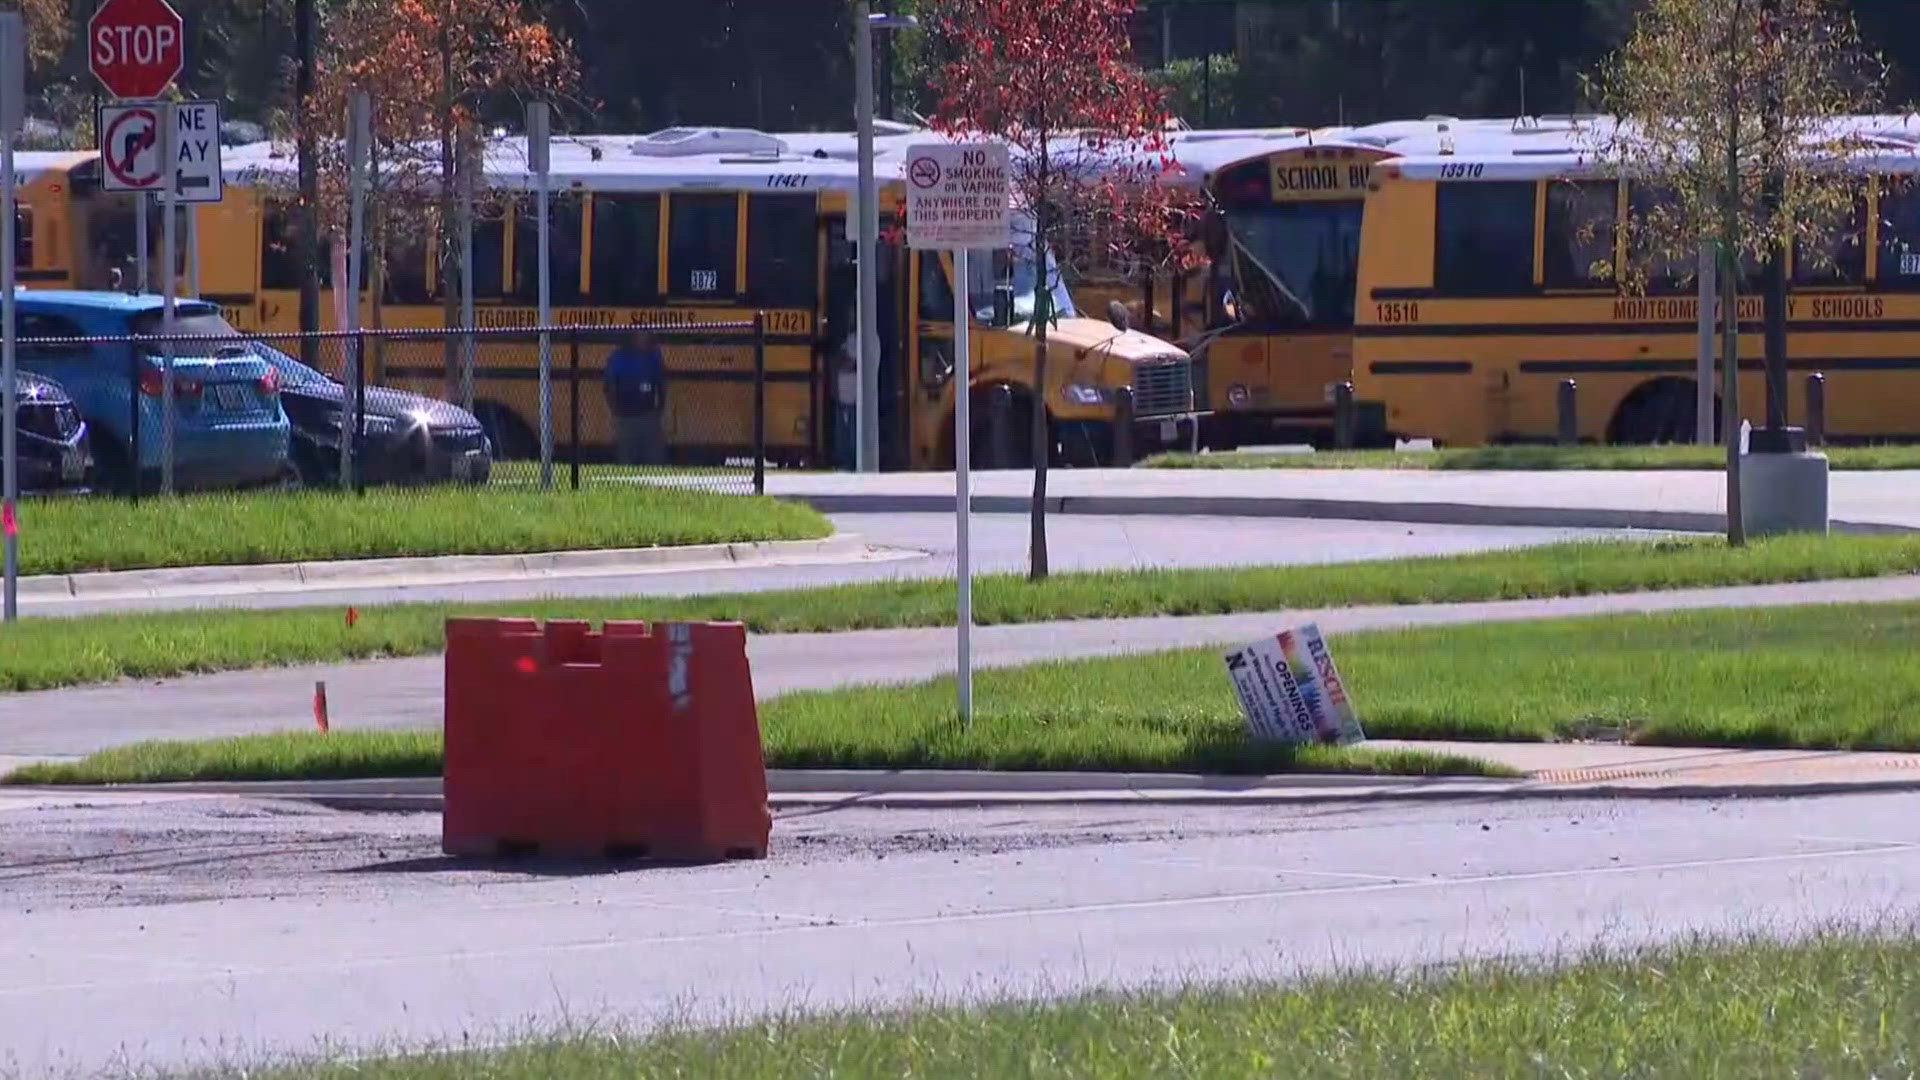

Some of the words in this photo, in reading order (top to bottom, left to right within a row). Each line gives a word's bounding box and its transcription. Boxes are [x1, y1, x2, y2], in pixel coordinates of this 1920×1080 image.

[96, 25, 175, 65] STOP
[178, 108, 206, 131] NE
[178, 140, 209, 162] AY
[963, 150, 986, 166] NO
[945, 167, 1005, 180] SMOKING
[1277, 164, 1338, 190] SCHOOL
[1349, 164, 1370, 188] BU
[1440, 162, 1485, 178] 13510
[766, 173, 808, 187] 17421
[961, 181, 1005, 194] VAPING
[916, 197, 978, 208] ANYWHERE
[983, 197, 1001, 208] ON
[914, 210, 939, 221] THIS
[943, 209, 1003, 221] PROPERTY
[1900, 254, 1920, 273] 387
[692, 270, 717, 290] 3872
[1376, 303, 1418, 322] 13510
[1812, 298, 1884, 317] SCHOOLS
[560, 310, 616, 326] COUNTY
[630, 309, 697, 325] SCHOOLS
[766, 312, 806, 331] 17421
[1225, 650, 1247, 671] N
[1276, 660, 1313, 732] OPENINGS
